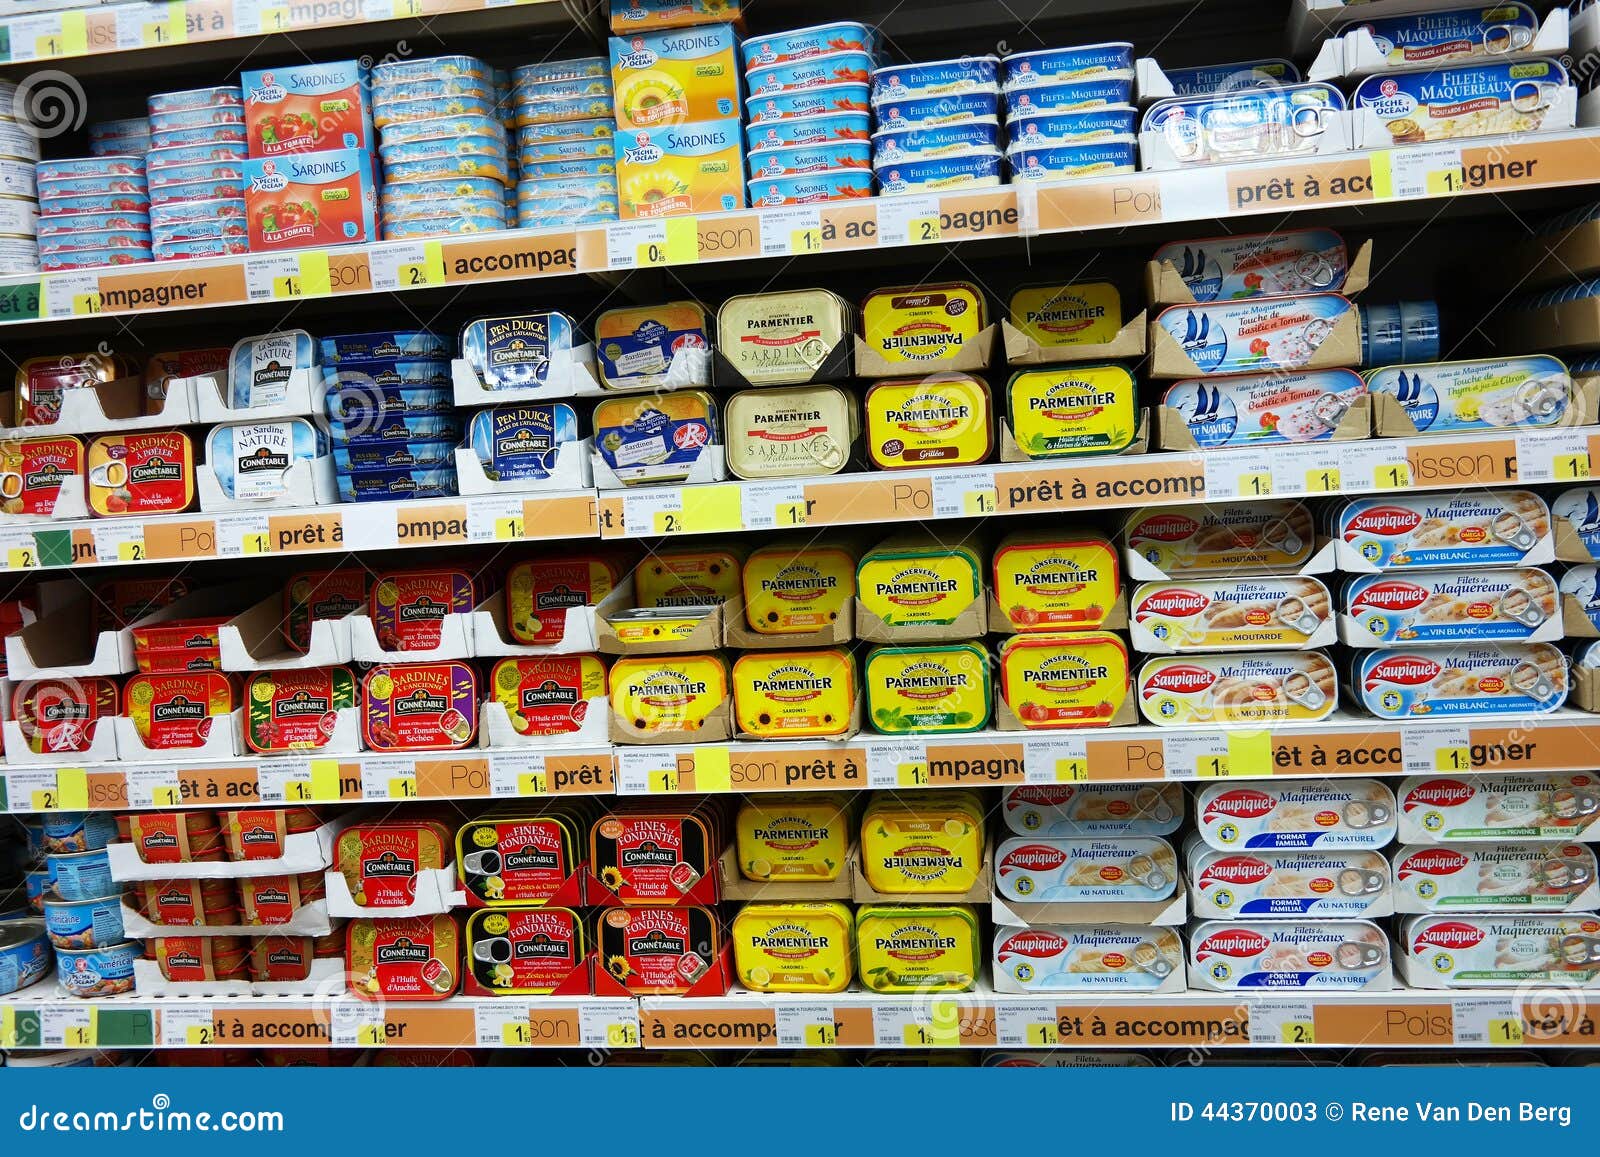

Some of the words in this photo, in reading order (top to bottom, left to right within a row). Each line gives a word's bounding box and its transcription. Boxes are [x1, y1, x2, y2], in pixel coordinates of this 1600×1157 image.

[1417, 16, 1456, 31] FILETS
[662, 35, 720, 53] SARDINES
[787, 39, 820, 52] SARDINES
[1071, 54, 1121, 67] MAQUEREAUX
[291, 71, 345, 90] SARDINES
[792, 68, 826, 82] SARDINES
[1442, 70, 1484, 88] FILETS
[1071, 87, 1120, 100] MAQUEREAUX
[1420, 79, 1512, 100] MAQUEREAUX
[792, 97, 825, 111] SARDINES
[1078, 118, 1128, 130] MAQUEREAUX
[793, 126, 827, 139] SARDINES
[668, 132, 726, 149] SARDINES
[794, 154, 828, 167] SARDINES
[1078, 149, 1128, 162] MAQUEREAUX
[292, 161, 346, 177] SARDINES
[794, 183, 828, 196] SARDINES
[1237, 178, 1294, 208] prêt
[1304, 173, 1321, 198] à
[1027, 306, 1104, 322] PARMENTIER
[1239, 312, 1267, 325] Touche
[512, 320, 545, 333] DUICK
[747, 315, 814, 329] PARMENTIER
[883, 333, 963, 350] PARMENTIER
[1045, 380, 1097, 396] CONSERVERIE
[1452, 377, 1481, 387] Touche
[1029, 393, 1115, 410] PARMENTIER
[497, 414, 518, 426] PEN
[519, 410, 551, 423] DUICK
[754, 410, 821, 423] PARMENTIER
[886, 406, 968, 423] PARMENTIER
[252, 424, 285, 434] Sardine
[129, 438, 181, 452] SARDINES
[238, 434, 288, 448] NATURE
[500, 440, 548, 451] CONNÉTABLE
[241, 456, 286, 467] CONNÉTABLE
[132, 466, 178, 478] CONNÉTABLE
[1009, 479, 1063, 508] prêt
[1072, 478, 1086, 498] à
[1355, 512, 1417, 528] Saupiquet
[1426, 507, 1504, 519] Maquereaux
[279, 522, 325, 548] prêt
[1138, 522, 1195, 536] Saupiquet
[1222, 554, 1268, 563] MOUTARDE
[1440, 552, 1470, 560] BLANC
[1030, 558, 1080, 573] CONSERVERIE
[891, 568, 939, 583] CONSERVERIE
[1015, 569, 1097, 586] PARMENTIER
[762, 576, 837, 591] PARMENTIER
[876, 579, 957, 595] PARMENTIER
[1433, 583, 1511, 595] Maquereaux
[1213, 590, 1288, 602] Maquereaux
[1362, 587, 1424, 604] Saupiquet
[1146, 595, 1205, 612] Saupiquet
[402, 606, 445, 617] CONNÉTABLE
[1234, 633, 1282, 641] MOUTARDE
[1446, 627, 1477, 635] BLANC
[901, 662, 949, 676] CONSERVERIE
[1039, 655, 1089, 670] CONSERVERIE
[1444, 657, 1522, 670] Maquereaux
[767, 666, 815, 680] CONSERVERIE
[1024, 666, 1107, 682] PARMENTIER
[1220, 666, 1294, 679] Maquereaux
[1375, 662, 1437, 679] Saupiquet
[392, 672, 450, 688] SARDINES
[753, 677, 832, 692] PARMENTIER
[886, 674, 967, 689] PARMENTIER
[1153, 670, 1213, 688] Saupiquet
[526, 690, 574, 701] CONNÉTABLE
[629, 681, 706, 696] PARMENTIER
[157, 705, 202, 715] CONNÉTABLE
[279, 701, 324, 712] CONNÉTABLE
[397, 700, 444, 710] CONNÉTABLE
[1459, 702, 1489, 710] BLANC
[1240, 709, 1289, 717] MOUTARDE
[554, 764, 602, 788] prêt
[785, 758, 836, 785] prêt
[845, 758, 858, 778] à
[1412, 786, 1473, 801] Saupiquet
[1480, 782, 1557, 793] Maquereaux
[1211, 797, 1274, 811] Saupiquet
[1279, 792, 1352, 803] Maquereaux
[513, 825, 545, 836] FINES
[634, 821, 666, 832] FINES
[618, 832, 681, 847] FONDANTES
[754, 827, 829, 841] PARMENTIER
[1336, 835, 1375, 843] NATUREL
[500, 836, 560, 850] FONDANTES
[508, 856, 554, 865] CONNÉTABLE
[625, 853, 673, 862] CONNÉTABLE
[1009, 851, 1064, 866] Saupiquet
[1071, 848, 1138, 859] Maquereaux
[1473, 851, 1549, 861] Maquereaux
[367, 861, 411, 872] CONNÉTABLE
[883, 857, 962, 869] PARMENTIER
[1274, 859, 1347, 870] Maquereaux
[1406, 855, 1466, 870] Saupiquet
[1206, 864, 1270, 878] Saupiquet
[525, 914, 558, 925] FINES
[641, 910, 674, 921] FINES
[510, 925, 571, 938] FONDANTES
[625, 920, 688, 935] FONDANTES
[766, 924, 812, 937] CONSERVERIE
[890, 925, 938, 939] CONSERVERIE
[1490, 926, 1566, 937] Maquereaux
[752, 935, 829, 949] PARMENTIER
[876, 937, 956, 949] PARMENTIER
[1072, 934, 1142, 945] Maquereaux
[1271, 932, 1345, 943] Maquereaux
[1422, 929, 1483, 943] Saupiquet
[517, 944, 565, 954] CONNÉTABLE
[632, 941, 681, 951] CONNÉTABLE
[1007, 938, 1065, 954] Saupiquet
[1204, 936, 1267, 951] Saupiquet
[380, 948, 426, 958] CONNÉTABLE
[652, 1019, 665, 1038] à
[1091, 1016, 1106, 1036] à
[1092, 1013, 1106, 1036] à
